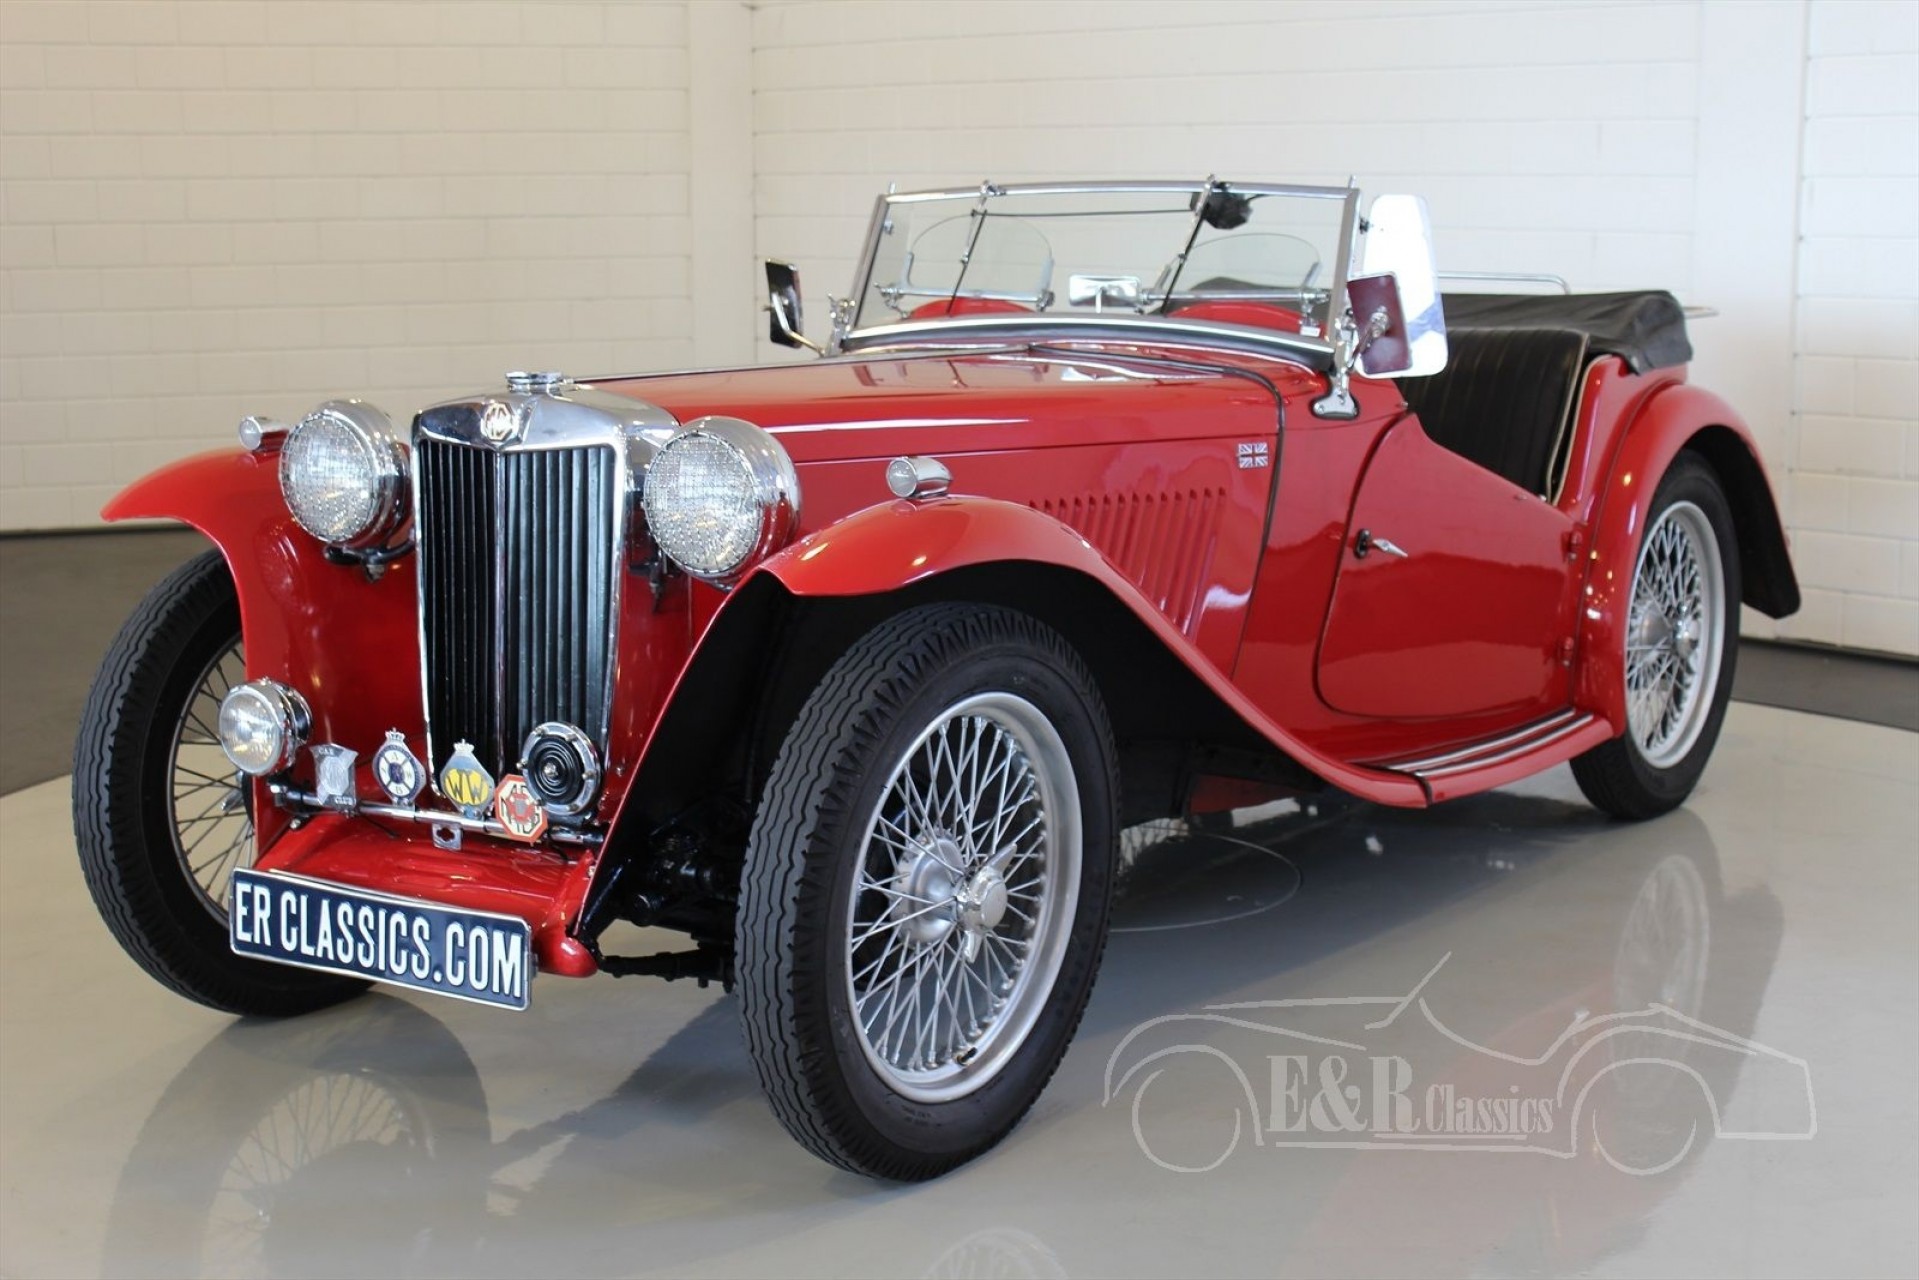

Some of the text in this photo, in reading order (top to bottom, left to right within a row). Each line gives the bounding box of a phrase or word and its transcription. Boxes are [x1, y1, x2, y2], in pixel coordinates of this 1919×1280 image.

[446, 768, 487, 804] WW
[235, 881, 522, 998] ER CLASSICS.COM
